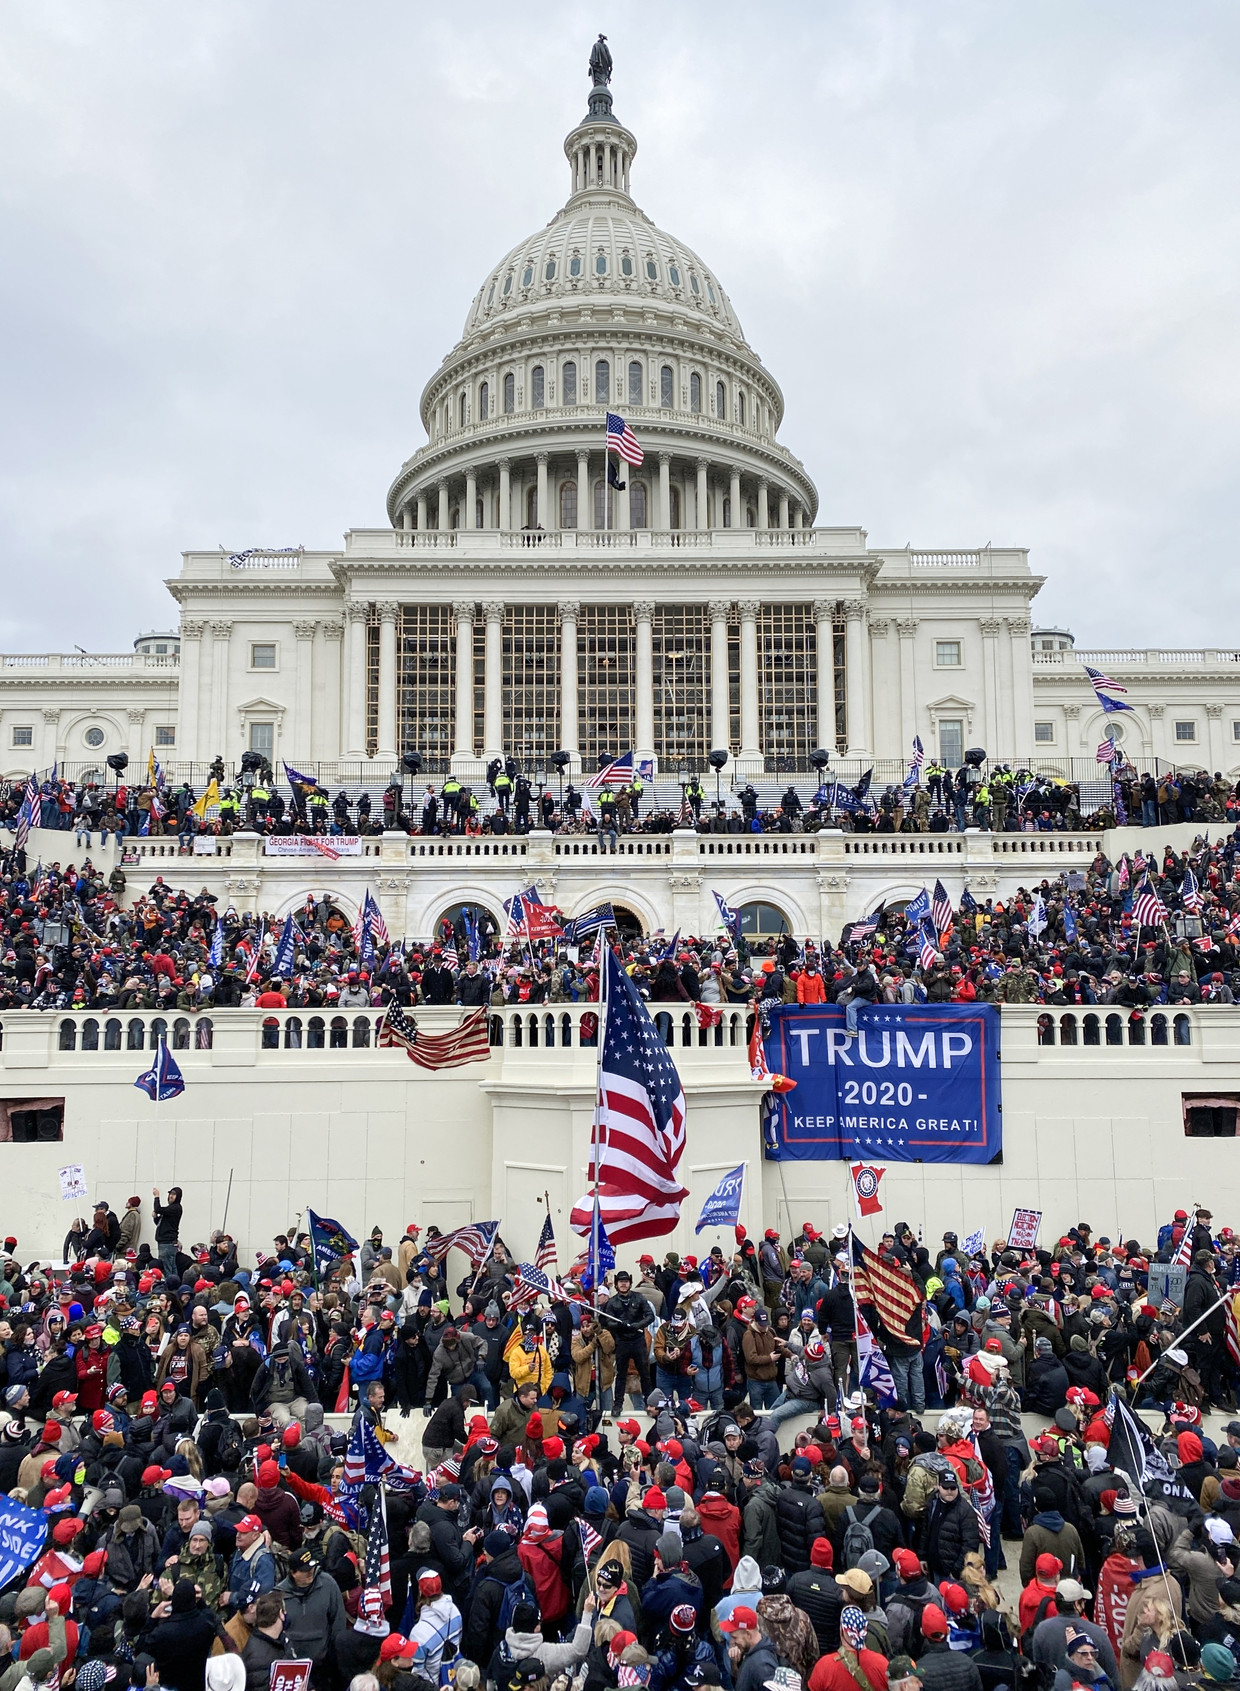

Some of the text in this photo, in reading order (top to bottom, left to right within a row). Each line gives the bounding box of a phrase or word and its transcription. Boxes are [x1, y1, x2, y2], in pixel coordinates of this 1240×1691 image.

[269, 837, 299, 846] GEORGIA
[321, 837, 334, 846] FOR
[336, 837, 359, 846] TRUMP
[790, 1028, 973, 1069] TRUMP
[794, 1116, 978, 1131] KEEP AMERICA GREAT!
[1163, 1483, 1180, 1497] ON
